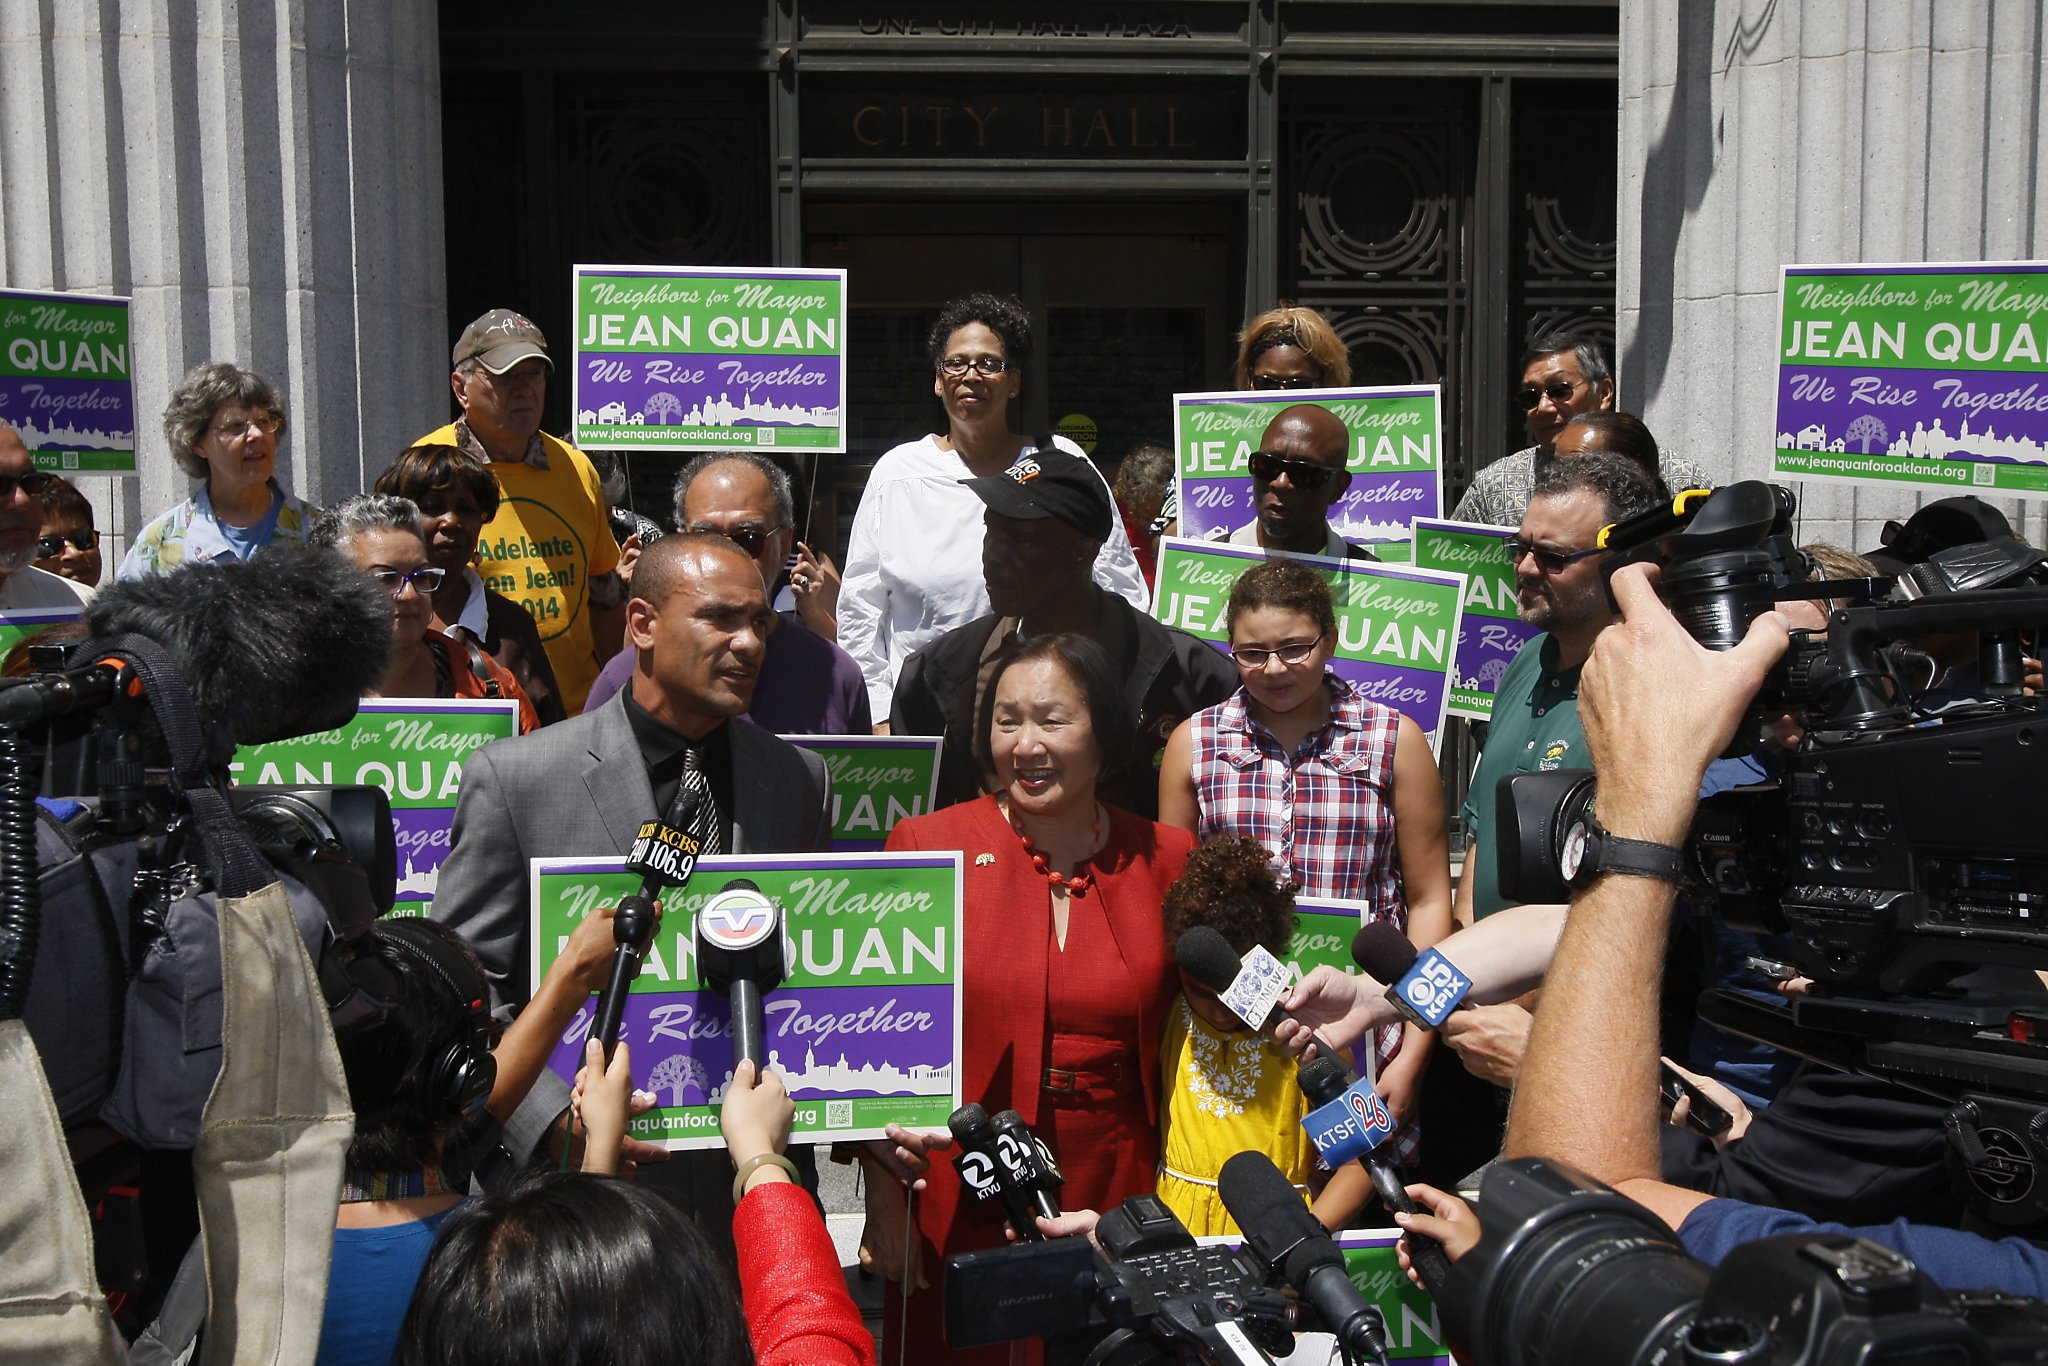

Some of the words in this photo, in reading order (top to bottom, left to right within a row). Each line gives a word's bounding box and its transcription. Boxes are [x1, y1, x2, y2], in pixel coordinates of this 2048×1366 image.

[852, 106, 999, 147] CITY
[1042, 106, 1198, 148] HALL
[590, 283, 701, 311] Neighbors
[705, 289, 730, 308] for
[733, 284, 827, 315] Mayor
[1796, 282, 1919, 315] Neighbors
[1923, 289, 1953, 311] for
[4, 310, 27, 328] for
[30, 306, 118, 339] Mayor
[582, 314, 691, 347] JEAN
[707, 316, 835, 349] QUAN
[8, 338, 127, 375] QUAN
[1785, 321, 1906, 360] JEAN
[1925, 322, 2048, 363] QUA
[588, 359, 633, 383] We
[644, 360, 706, 385] Rise
[717, 361, 827, 392] Together
[20, 384, 122, 416] Together
[1789, 374, 1836, 402] We
[1848, 376, 1918, 406] Rise
[1932, 379, 2048, 418] Togethe
[579, 427, 752, 443] www.jeanquanforoakland.org
[1185, 440, 1252, 473] JEA
[1346, 434, 1431, 467] UAN
[1777, 454, 1967, 480] www.jeanquanforoakland.org
[1191, 485, 1235, 509] We
[478, 535, 574, 561] Adelante
[482, 574, 516, 593] on
[525, 562, 575, 590] Jean!
[1464, 575, 1518, 611] AN
[515, 596, 561, 620] 014
[1338, 615, 1446, 664] UAN
[351, 727, 381, 748] for
[657, 825, 700, 855] KCBS
[1703, 833, 1730, 842] Canon
[645, 840, 693, 881] 106.9
[789, 878, 933, 924] Mayor
[789, 926, 945, 979] UAN
[1290, 932, 1344, 958] yor
[1420, 955, 1453, 988] 5
[1425, 974, 1465, 1019] KPIX
[765, 998, 933, 1048] Together
[1350, 1091, 1391, 1133] 26
[1313, 1117, 1357, 1152] KTSF
[997, 1133, 1022, 1171] 2
[962, 1151, 995, 1189] 2
[1012, 1165, 1028, 1182] KTVU
[976, 1181, 1001, 1200] KTVU
